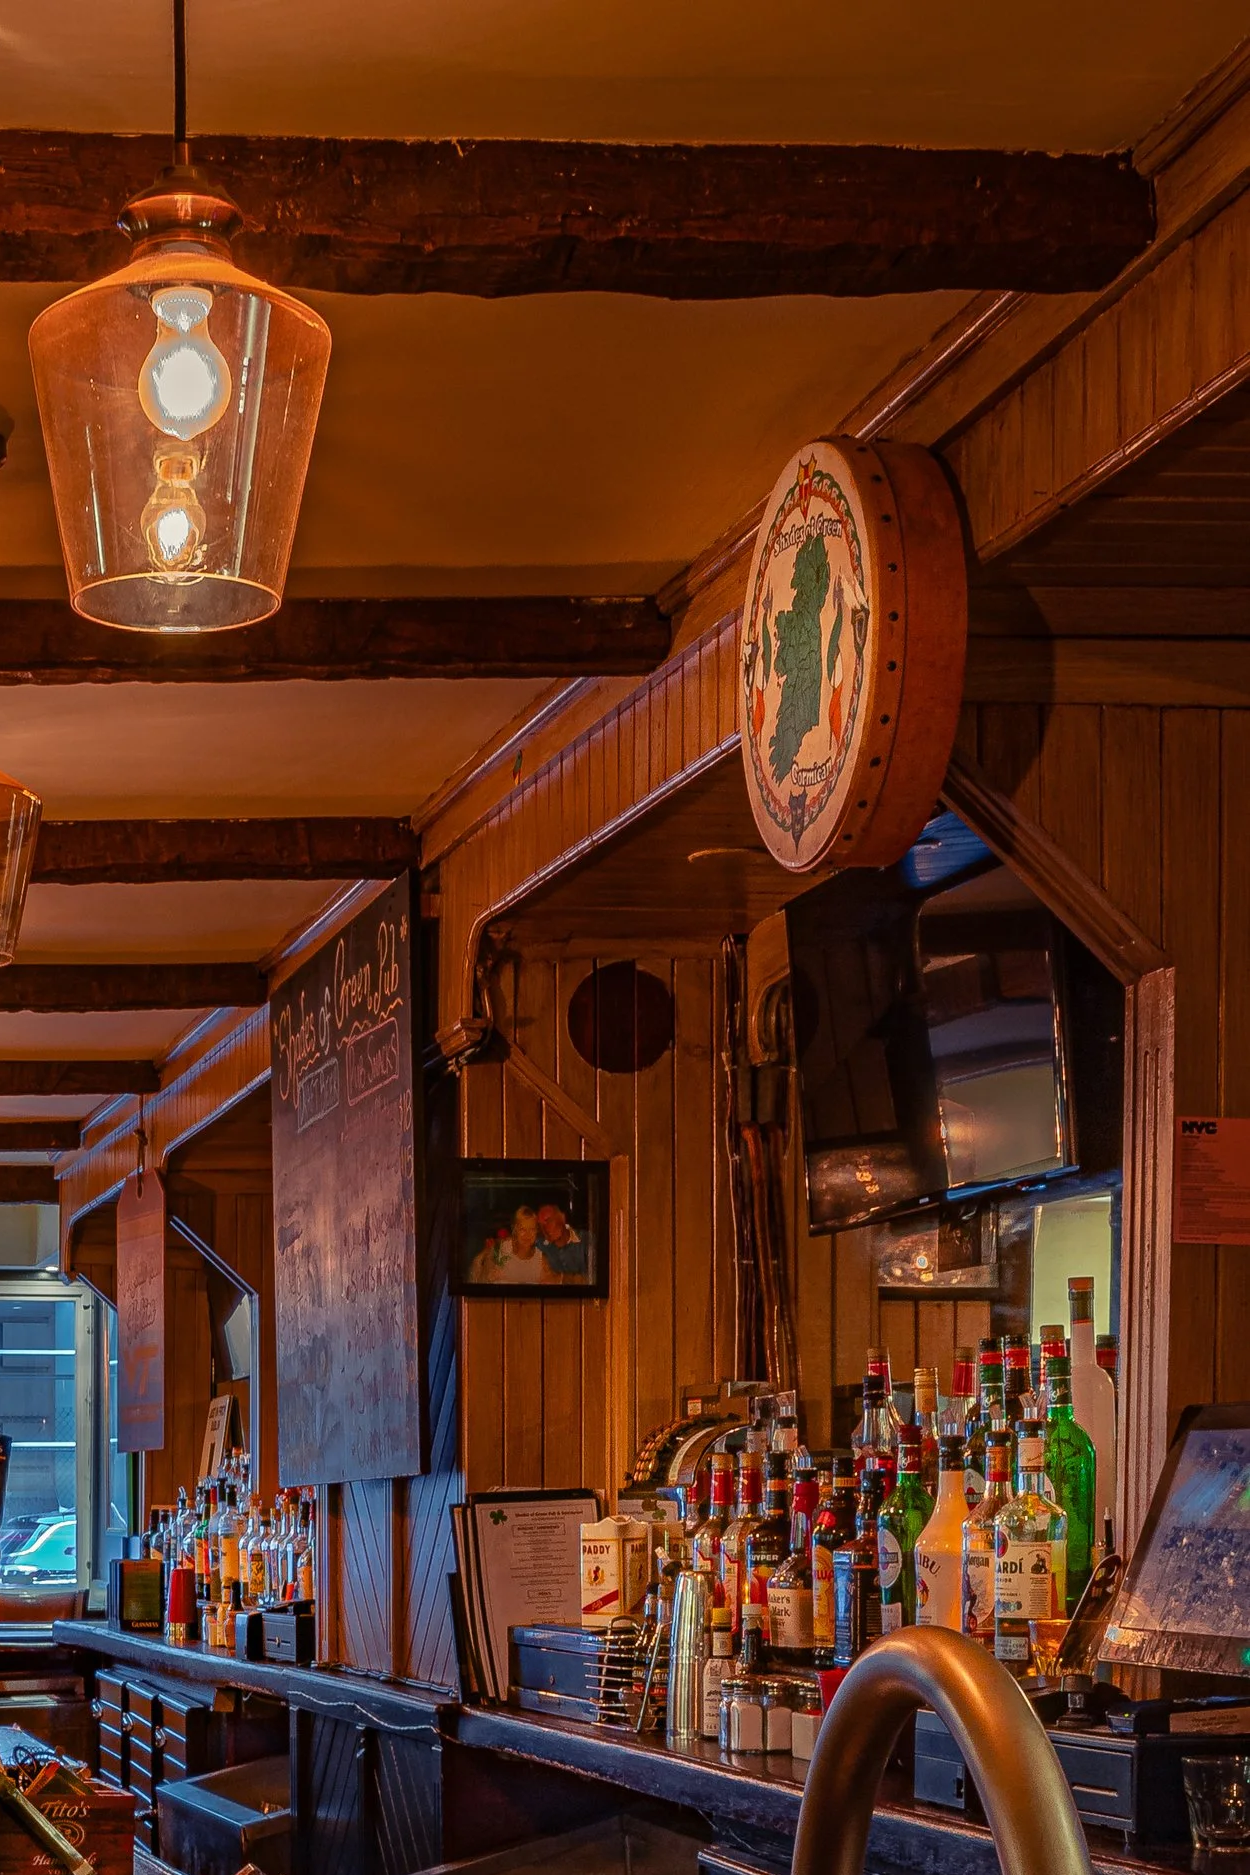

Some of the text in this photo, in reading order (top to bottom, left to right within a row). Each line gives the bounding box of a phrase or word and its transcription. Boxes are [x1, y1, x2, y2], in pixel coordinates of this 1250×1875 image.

[774, 512, 842, 557] Shades of Green
[791, 756, 833, 787] Cormican
[279, 921, 399, 1110] Shades of Green Pub
[1181, 1121, 1217, 1134] NYC
[583, 1544, 610, 1555] PADDY
[919, 1553, 941, 1575] IBU
[997, 1557, 1024, 1574] ARDÍ
[769, 1594, 790, 1604] aker's
[40, 1800, 90, 1817] Tito's
[32, 1851, 97, 1866] Hande
